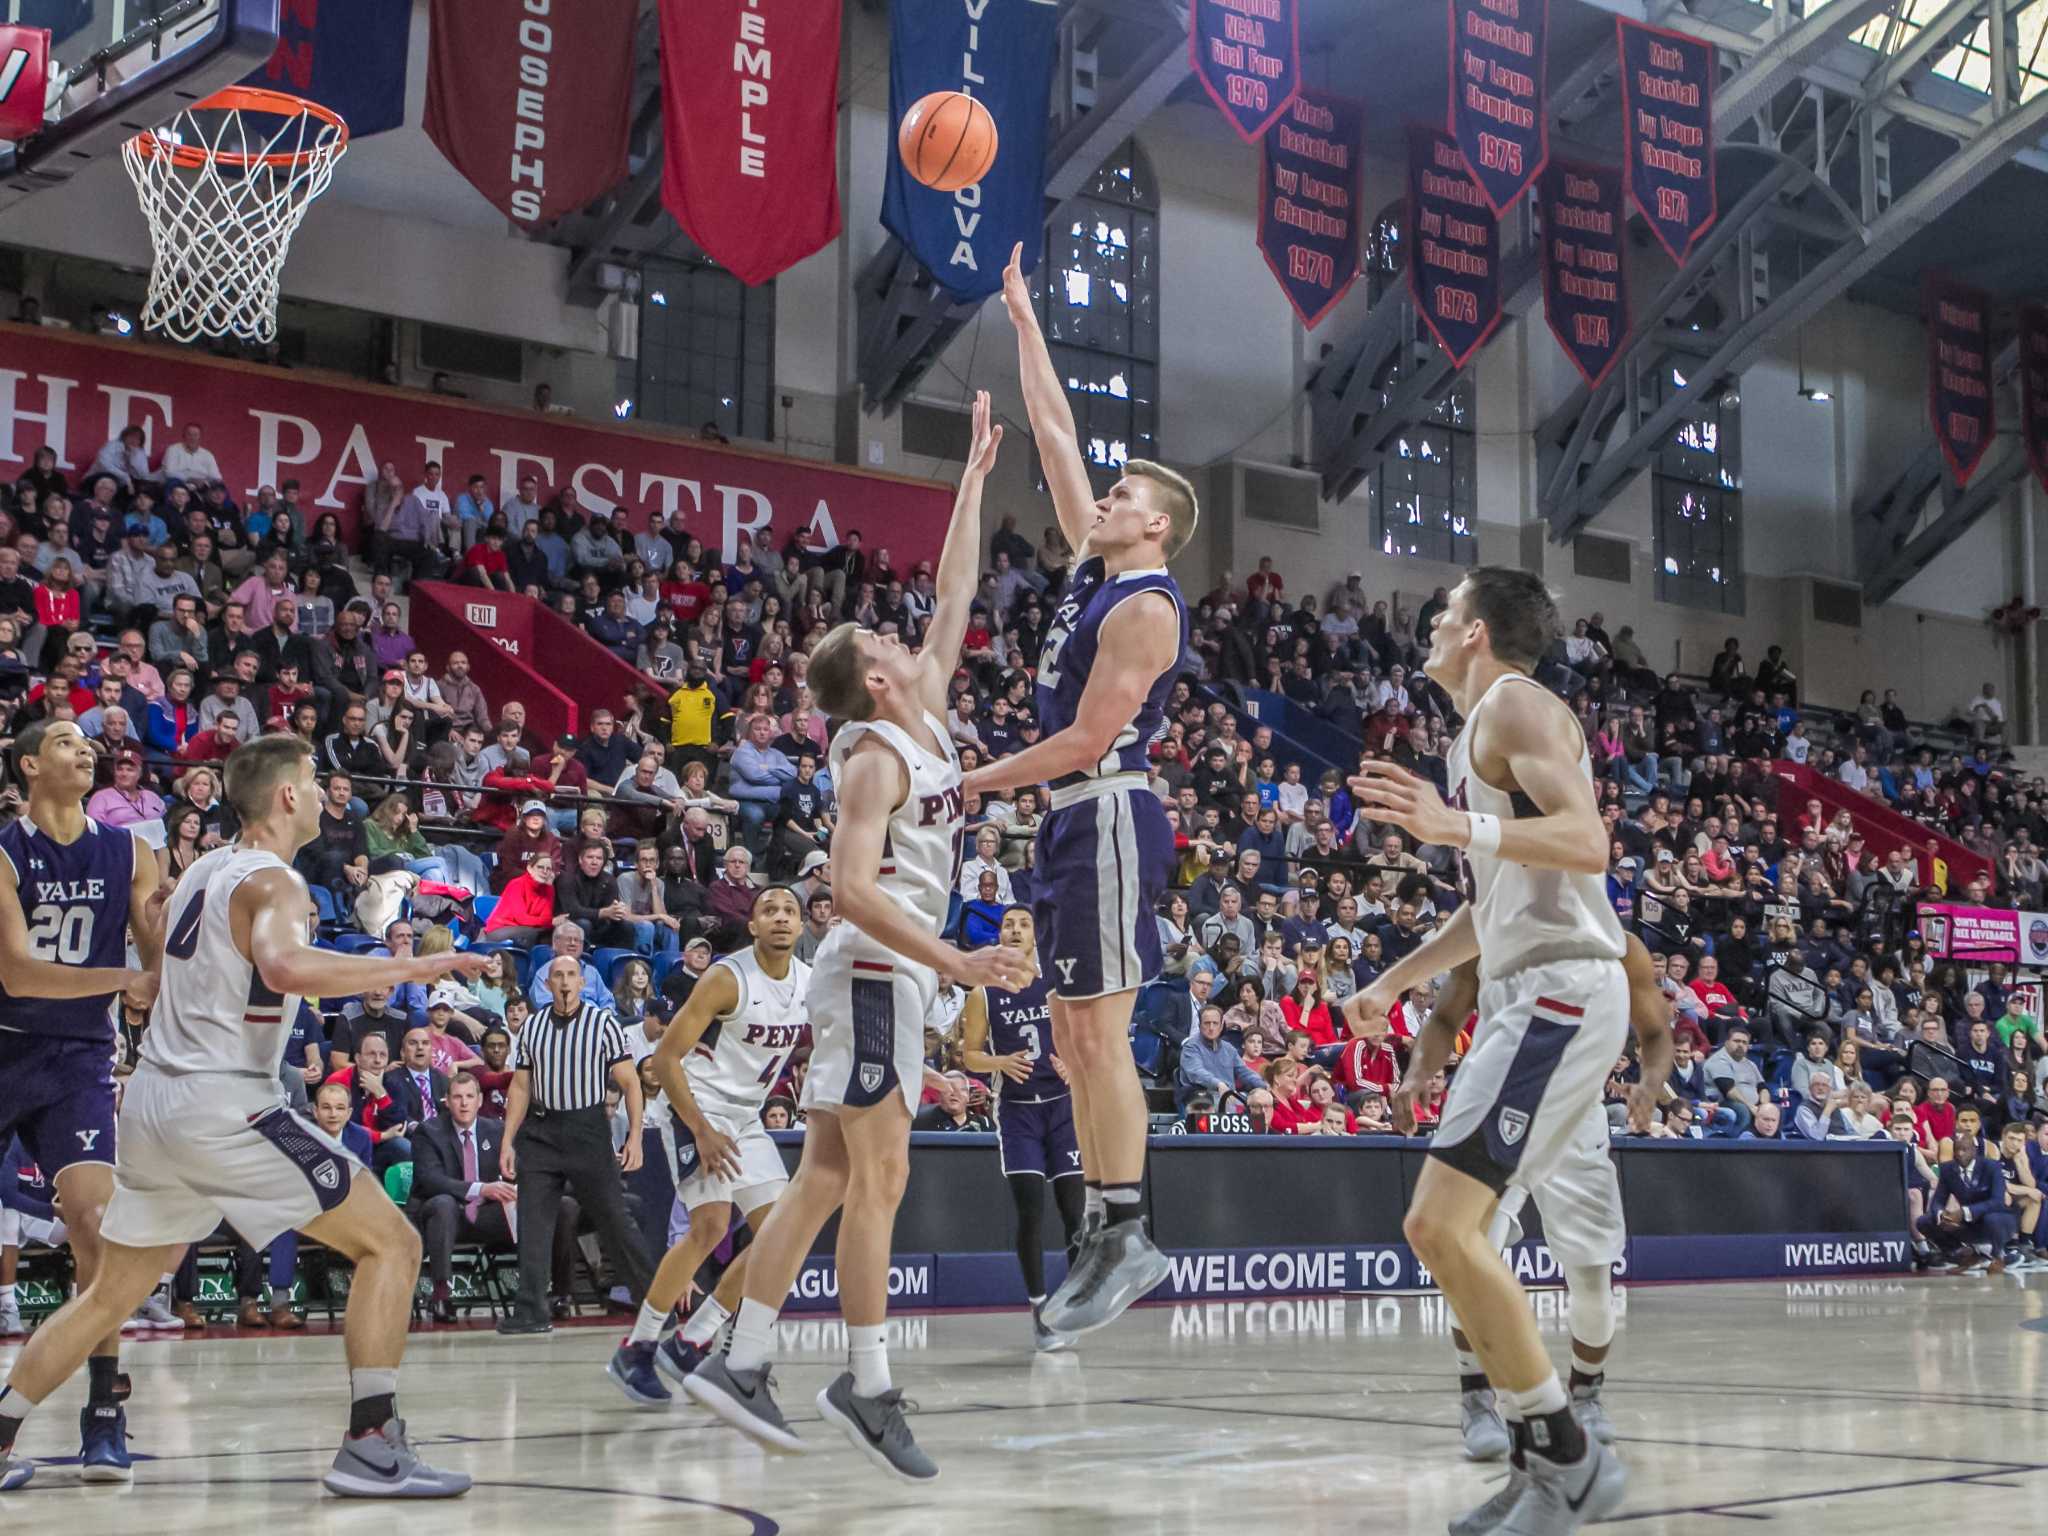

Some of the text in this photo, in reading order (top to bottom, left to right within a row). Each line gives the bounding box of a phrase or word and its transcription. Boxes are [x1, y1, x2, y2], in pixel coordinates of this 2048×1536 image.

[1224, 13, 1265, 48] NCAA
[1467, 10, 1533, 57] Basketball
[1210, 36, 1283, 79] Final Four
[1464, 49, 1534, 97] Ivy League
[734, 0, 771, 178] EMPLE
[1225, 73, 1268, 112] 1979
[1466, 82, 1534, 129] Champions
[1638, 70, 1700, 108] Basketball
[1637, 108, 1703, 146] Ivy League
[1279, 124, 1347, 169] Basketball
[1478, 131, 1523, 176] 1975
[1640, 141, 1701, 178] Champions
[1275, 163, 1348, 208] Ivy League
[1273, 197, 1347, 239] Champions
[1420, 207, 1488, 246] Ivy League
[1287, 244, 1334, 289] 1970
[1421, 239, 1488, 277] Champions
[1434, 284, 1478, 324] 1973
[471, 606, 491, 624] EXIT
[36, 878, 105, 903] YALE
[1645, 902, 1659, 913] 105
[28, 904, 95, 964] 20
[1055, 958, 1078, 985] Y
[1000, 1004, 1051, 1025] YALE
[1018, 1024, 1042, 1061] 3
[75, 1129, 100, 1152] Y
[1209, 1114, 1253, 1133] POSS.
[1068, 1151, 1081, 1166] Y
[1169, 1253, 1346, 1293] WELCOME
[1355, 1250, 1400, 1286] TO
[1785, 1240, 1905, 1267] IVYLEAGUE.TV
